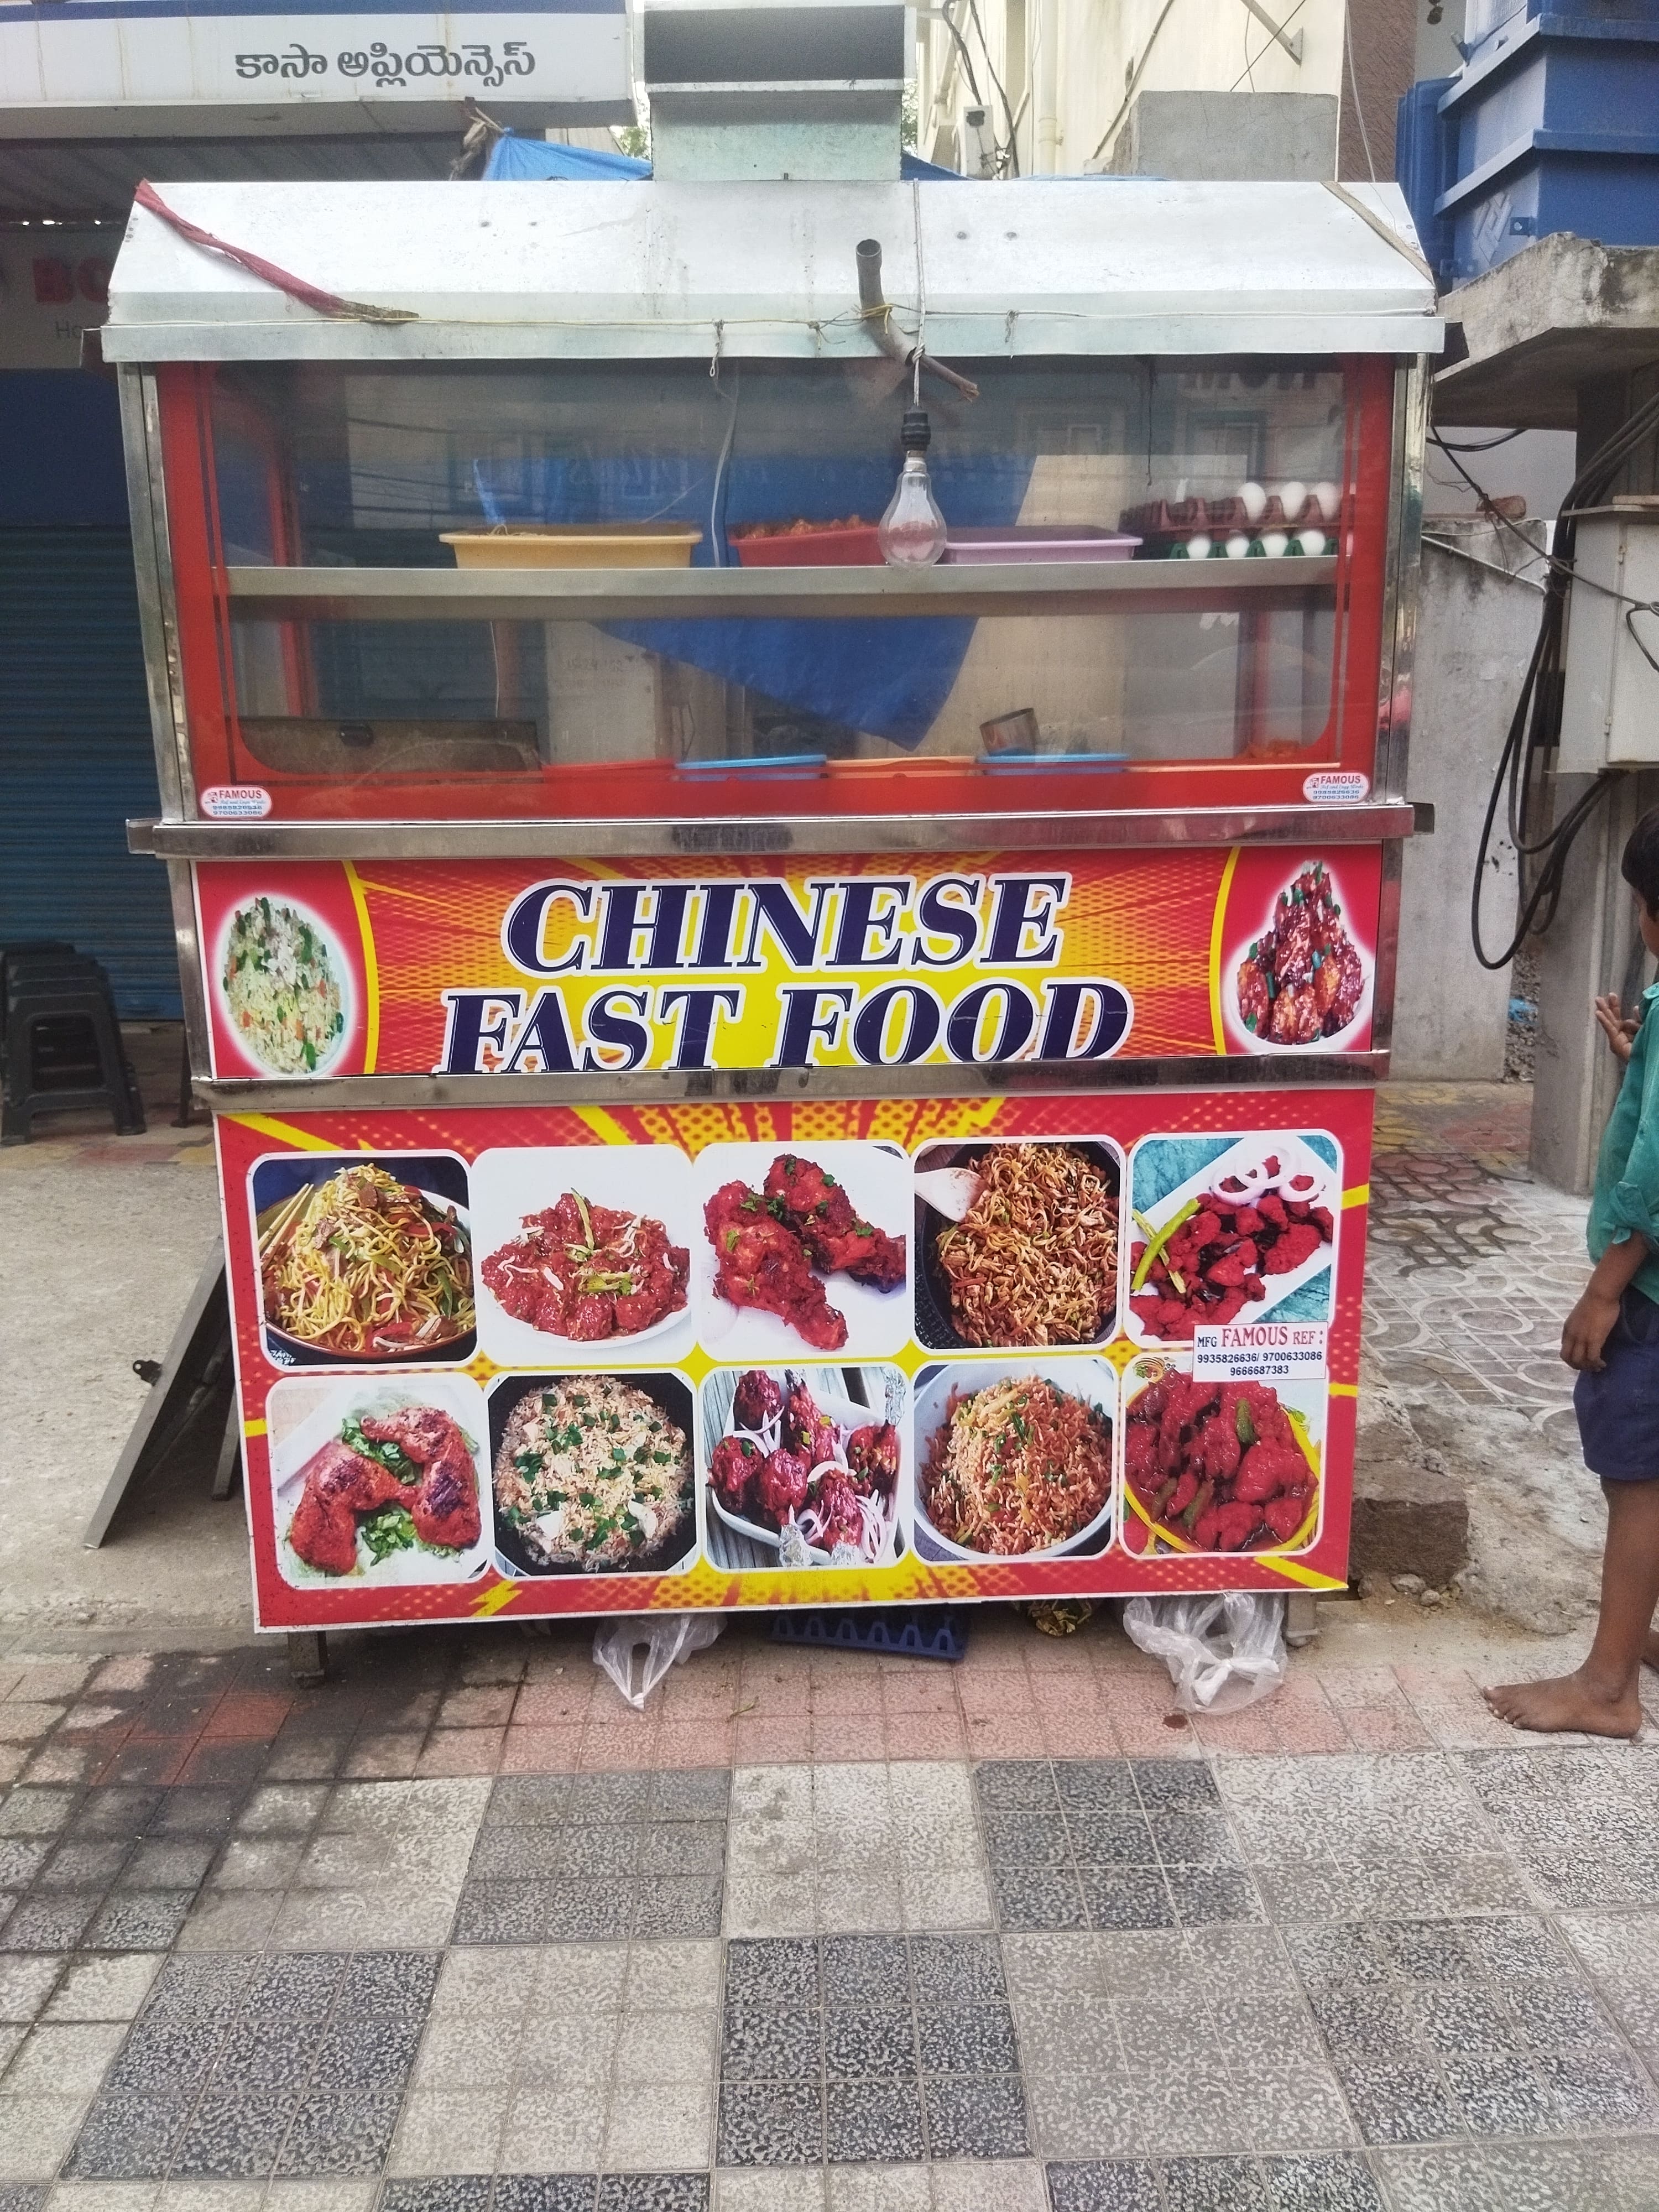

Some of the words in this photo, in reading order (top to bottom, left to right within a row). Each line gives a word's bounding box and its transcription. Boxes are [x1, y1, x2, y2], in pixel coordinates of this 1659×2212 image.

[235, 43, 328, 79] కాసా
[1321, 775, 1360, 784] FAMOUS
[219, 790, 262, 799] FAMOUS
[502, 876, 1070, 975] CHINESE
[441, 988, 741, 1074] FAST
[770, 981, 1134, 1070] FOOD
[1197, 1336, 1217, 1348] MFG
[1221, 1326, 1288, 1347] FAMOUS
[1262, 1351, 1322, 1361] 9700633086
[1230, 1365, 1289, 1376] 9666687383
